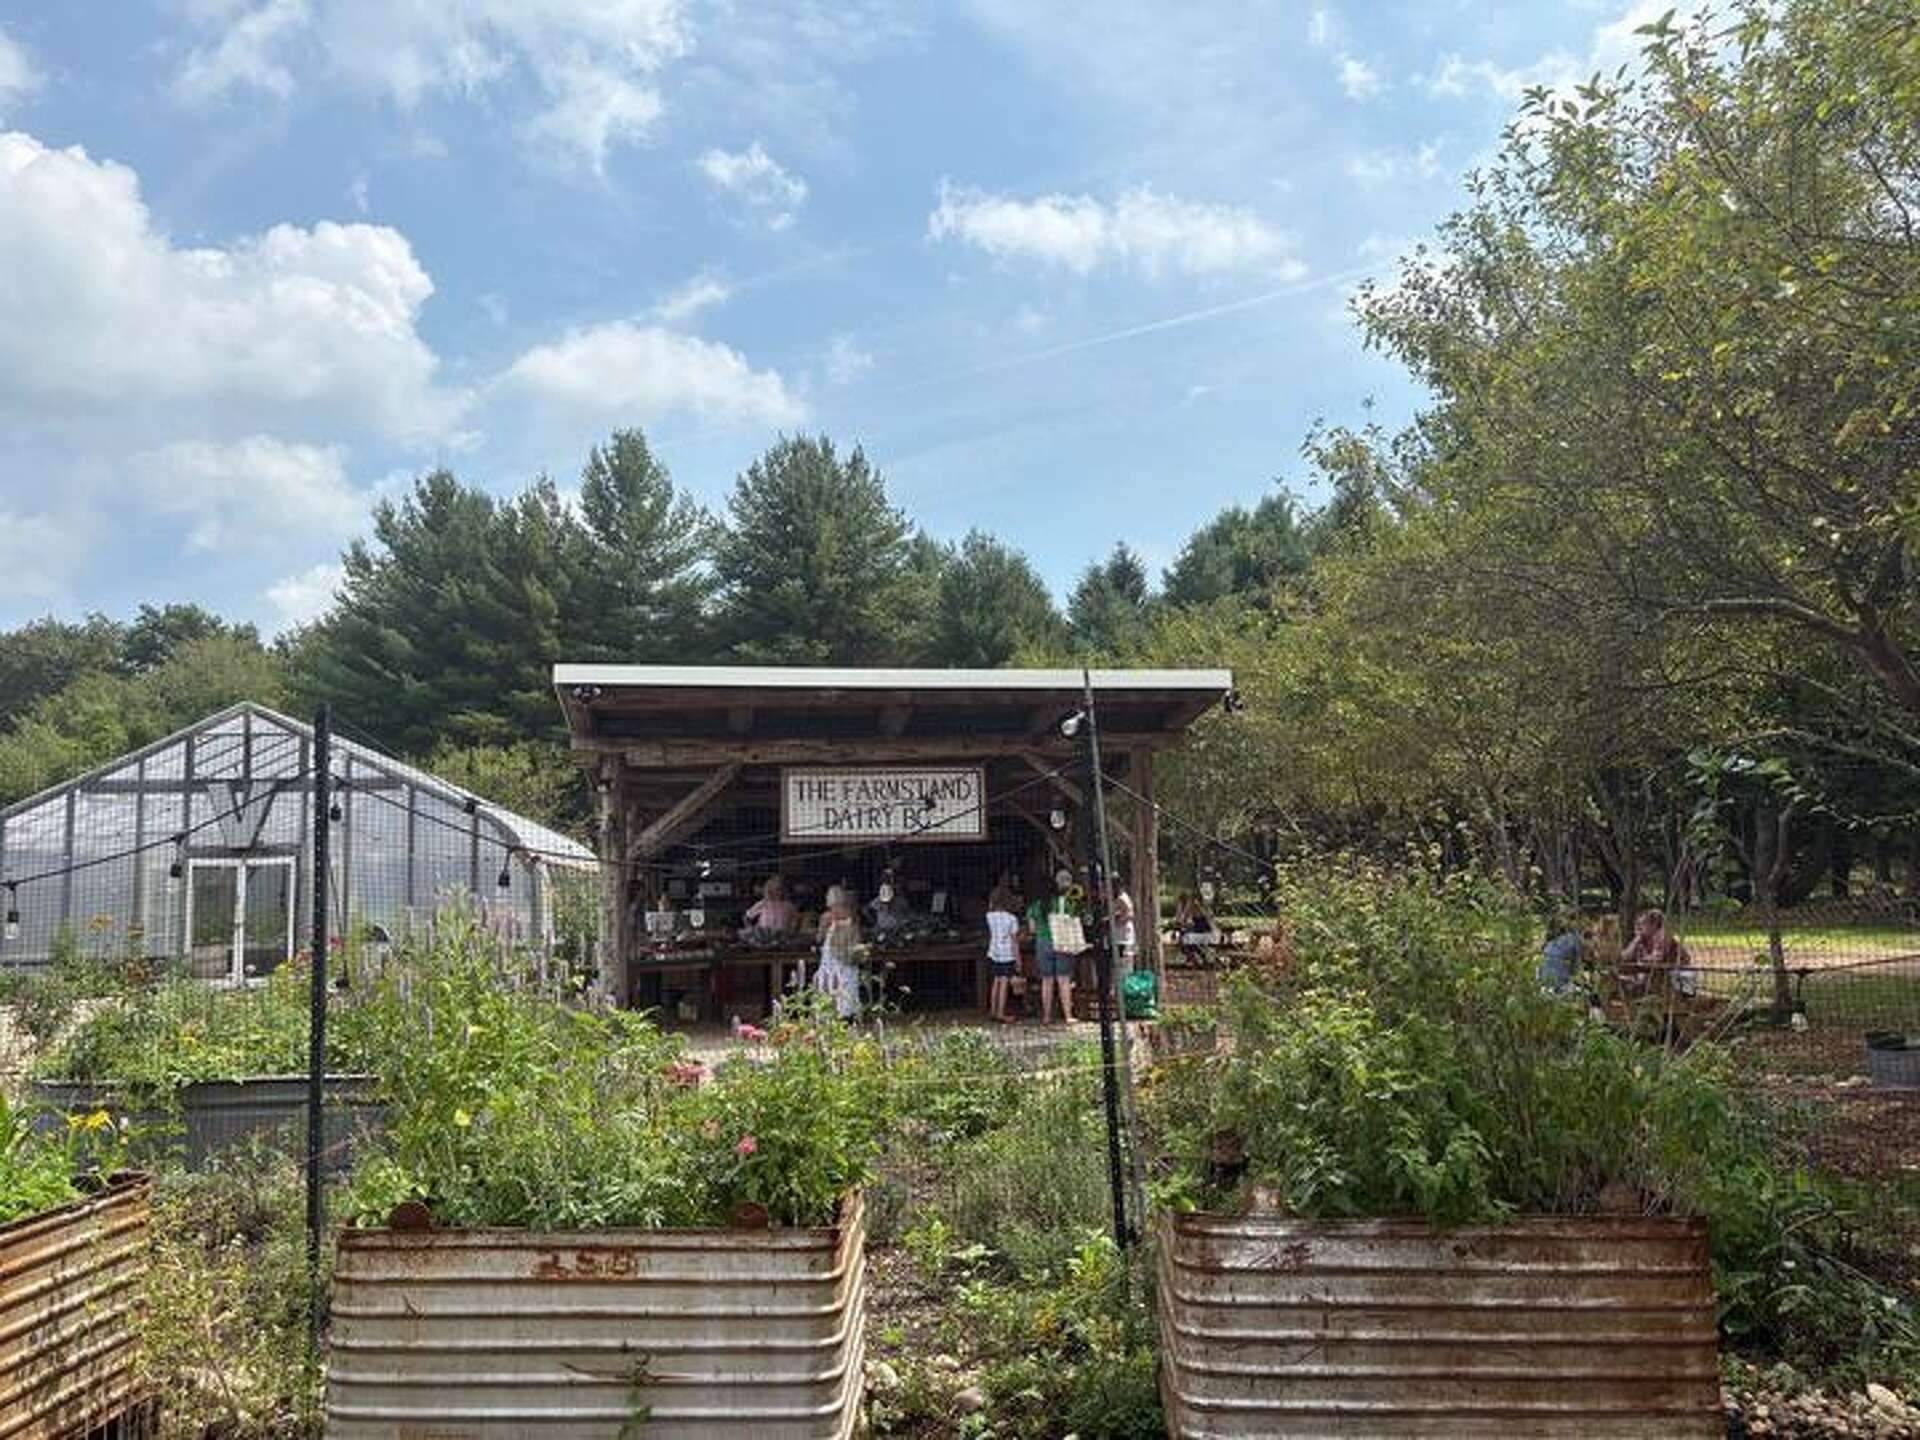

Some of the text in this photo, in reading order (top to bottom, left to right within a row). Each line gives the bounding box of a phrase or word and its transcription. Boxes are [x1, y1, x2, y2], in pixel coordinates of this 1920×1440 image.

[796, 778, 971, 801] THE FARMSTAND
[824, 807, 894, 829] DAIRY
